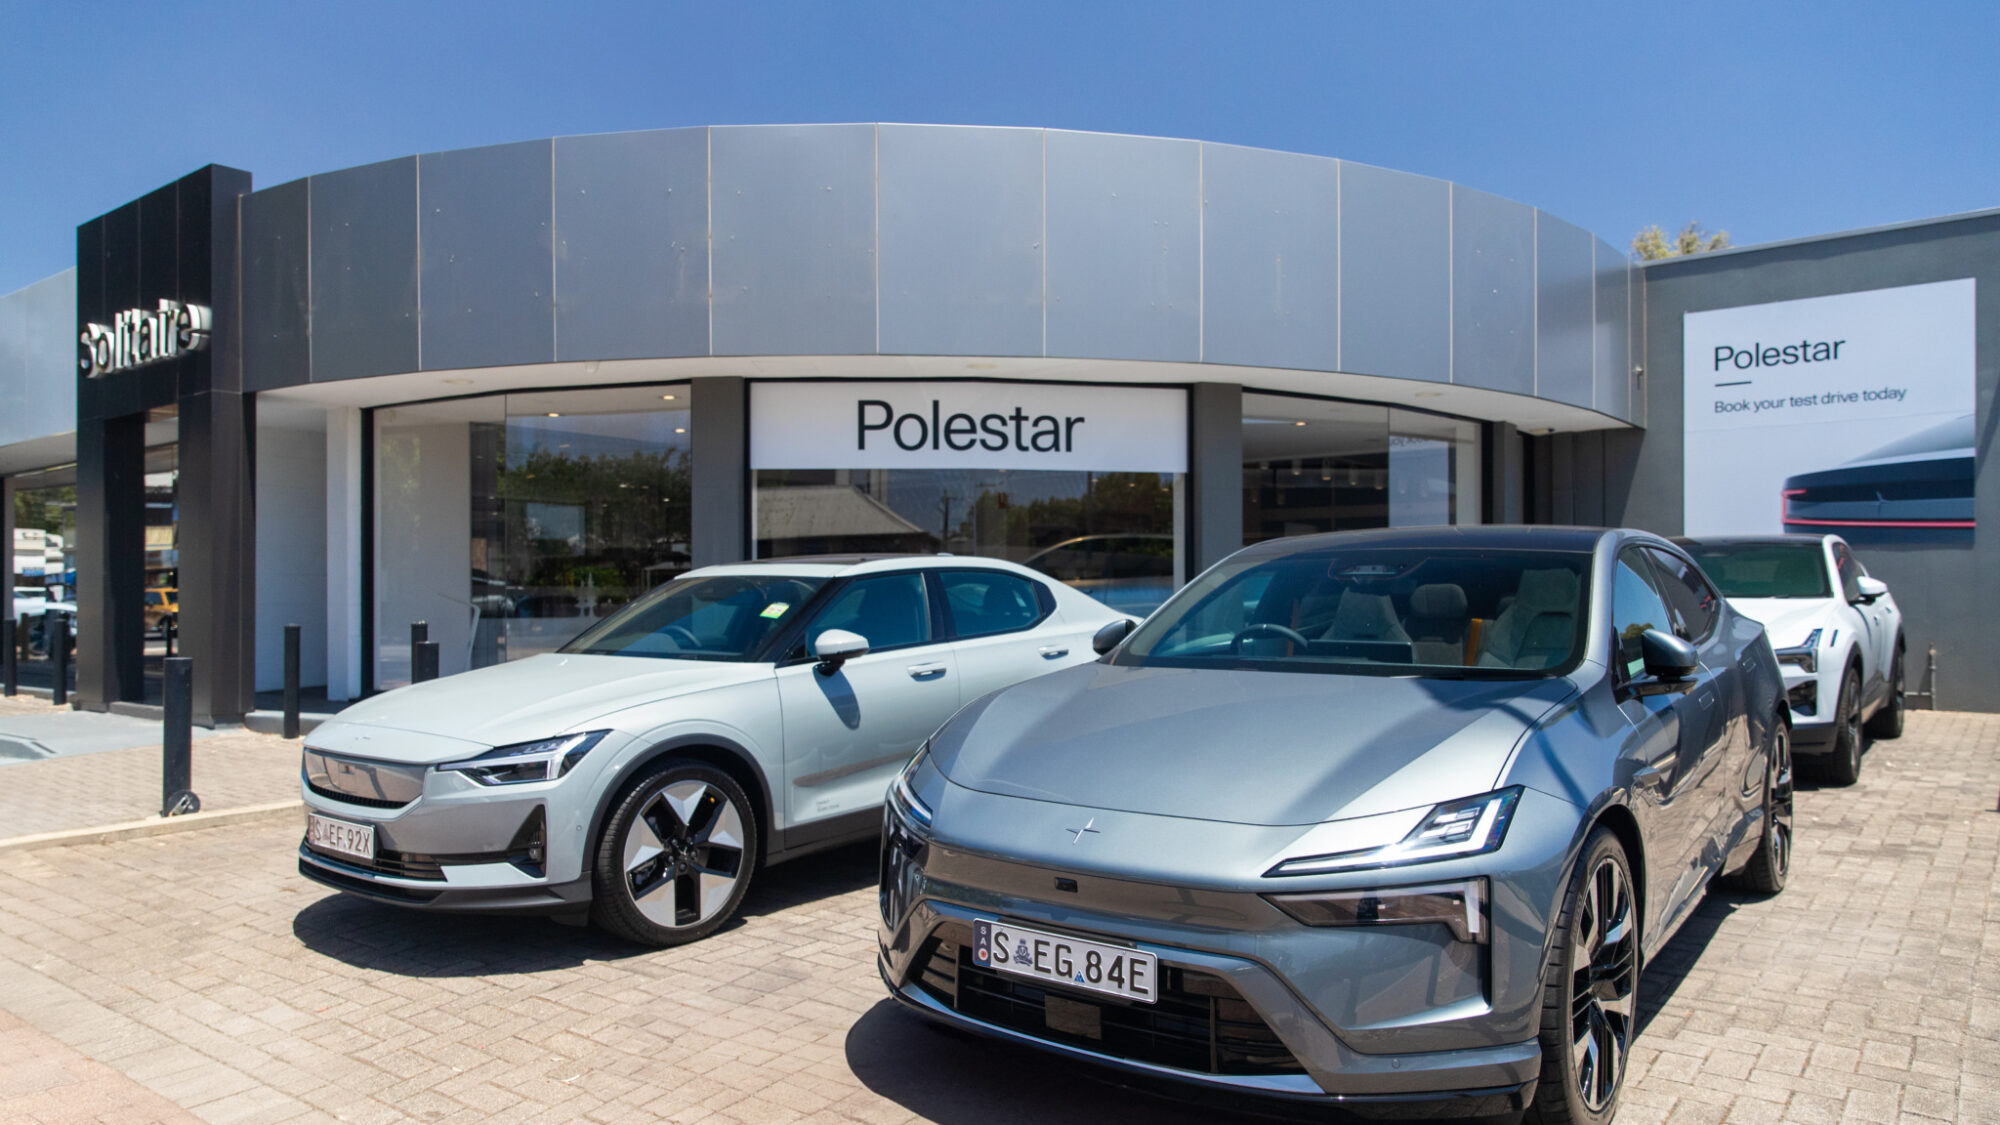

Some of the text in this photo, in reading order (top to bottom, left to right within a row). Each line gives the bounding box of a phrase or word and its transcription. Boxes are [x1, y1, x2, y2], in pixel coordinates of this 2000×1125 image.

[1714, 340, 1846, 371] Polestar
[1714, 387, 1907, 413] Book your test drive today
[857, 399, 1085, 452] Polestar
